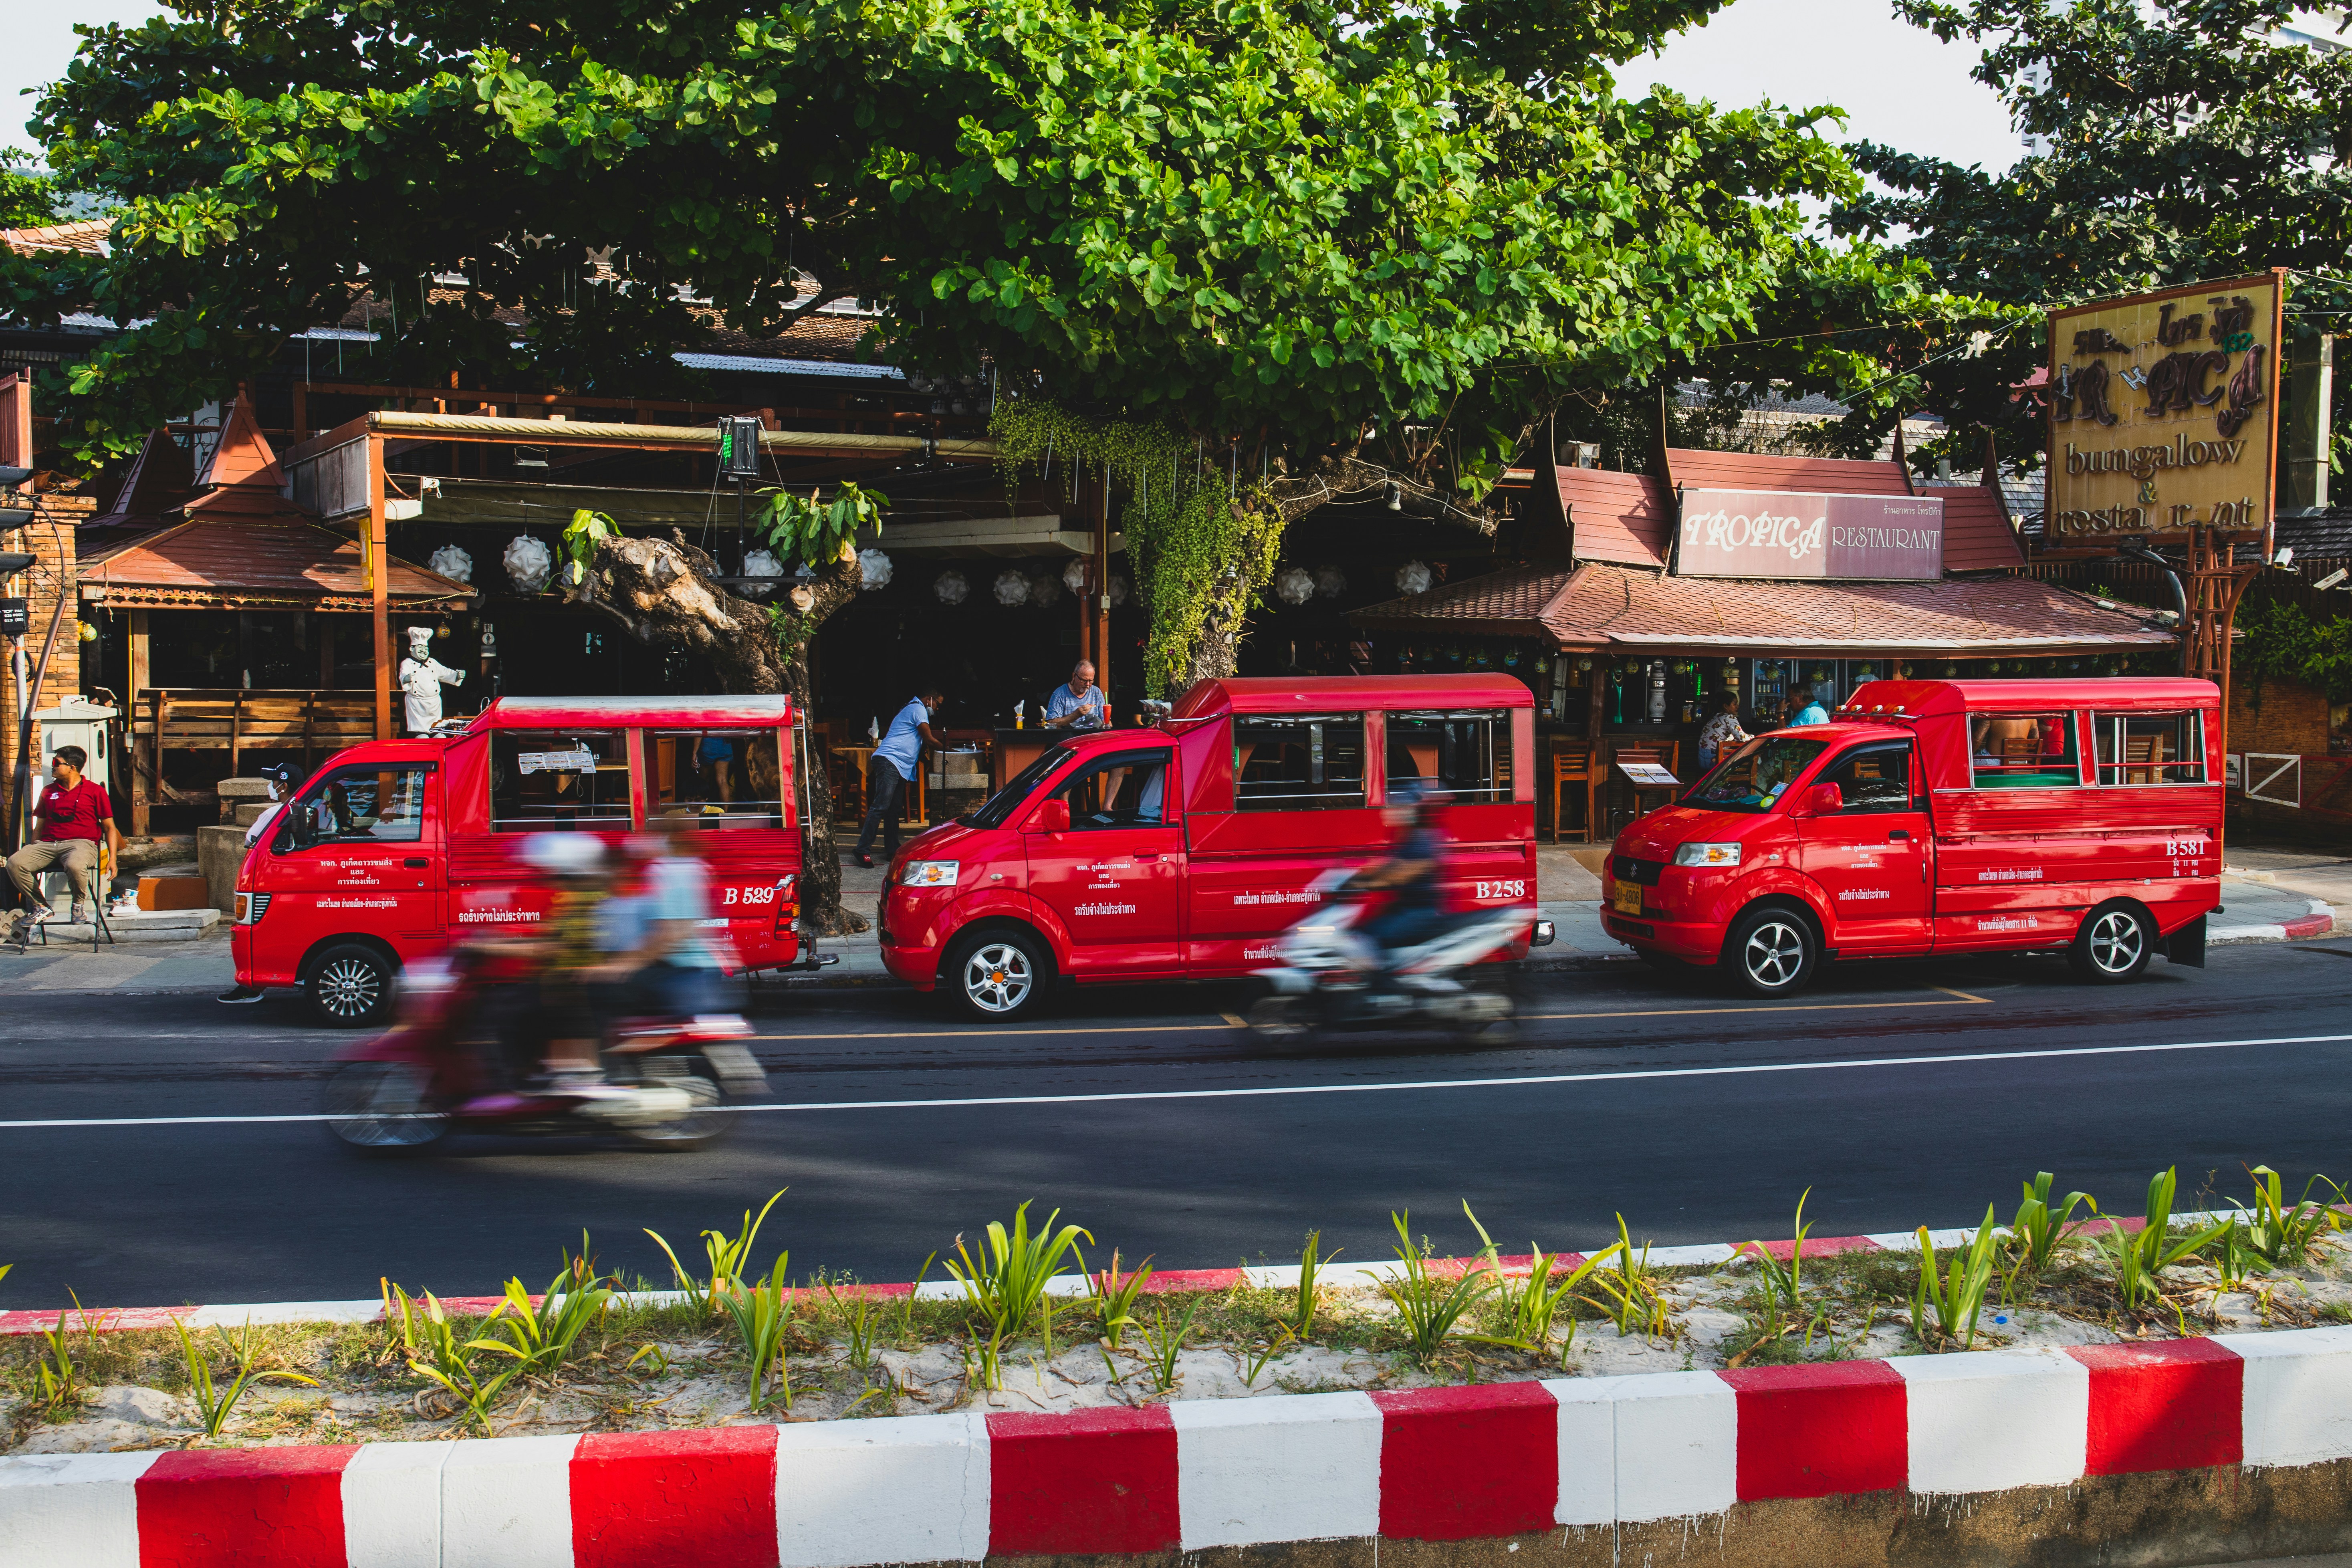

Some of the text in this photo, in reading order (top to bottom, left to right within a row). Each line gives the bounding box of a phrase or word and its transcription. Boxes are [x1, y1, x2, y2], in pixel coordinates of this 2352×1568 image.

[2223, 333, 2253, 354] 132
[2051, 344, 2264, 437] TRPICA
[2064, 432, 2245, 480] bungalow
[2138, 482, 2157, 504] &
[1884, 505, 1941, 515] ร้านอาหาร โทรปิก้า
[2054, 496, 2256, 533] restarnt
[1685, 509, 1940, 559] TROPICA RESTAURANT
[340, 857, 392, 868] ภูเก็ตถาวรขนส่ง
[337, 874, 380, 885] การท่องเที่ยว
[1088, 879, 1120, 889] การท่องเที่ยว
[722, 887, 774, 904] B 529
[459, 907, 540, 922] รถรับจ้างไม่ประจำทาง
[1074, 902, 1136, 916] รถรับจ้างไม่ประจำทาง
